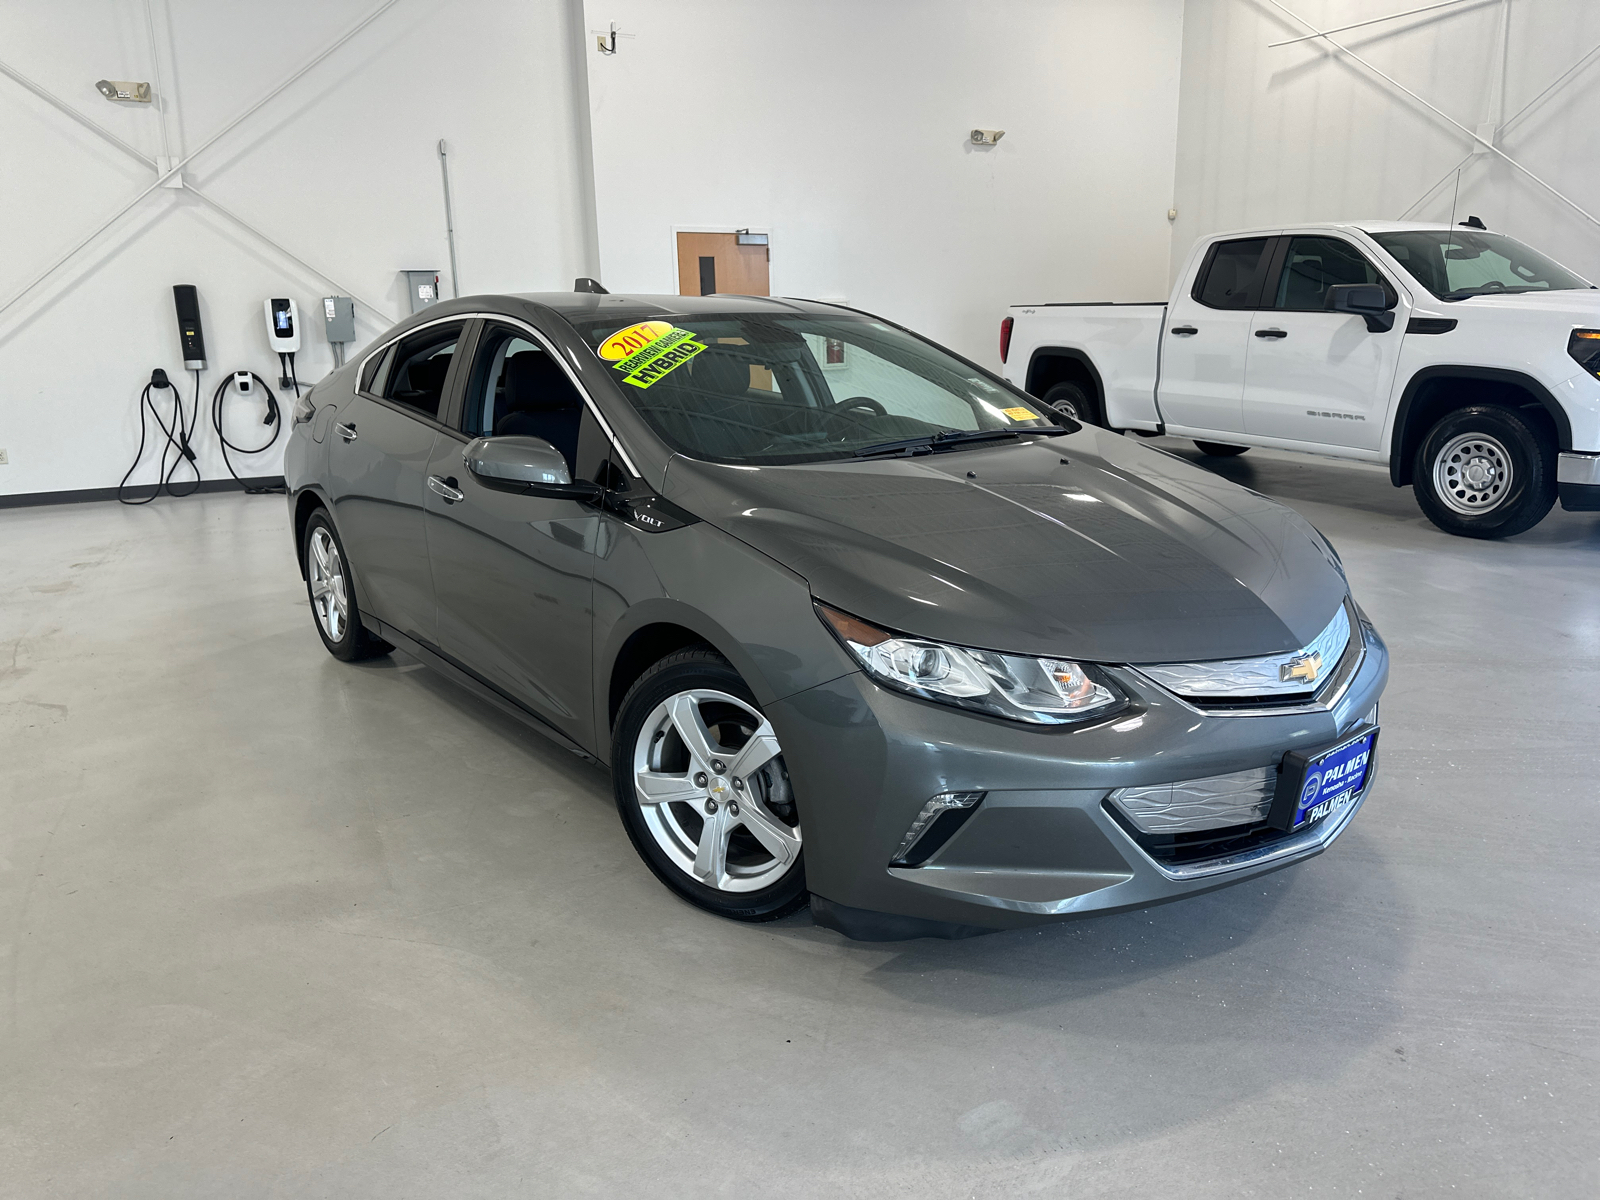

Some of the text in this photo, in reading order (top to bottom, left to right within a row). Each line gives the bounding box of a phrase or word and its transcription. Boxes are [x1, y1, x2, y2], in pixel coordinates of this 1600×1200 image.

[612, 324, 659, 356] 2017
[618, 347, 661, 373] REARVIEW
[631, 342, 701, 384] HYBRID
[634, 509, 665, 528] VOLT
[1321, 749, 1370, 786] PALMEN
[1309, 788, 1353, 824] PALMEN
